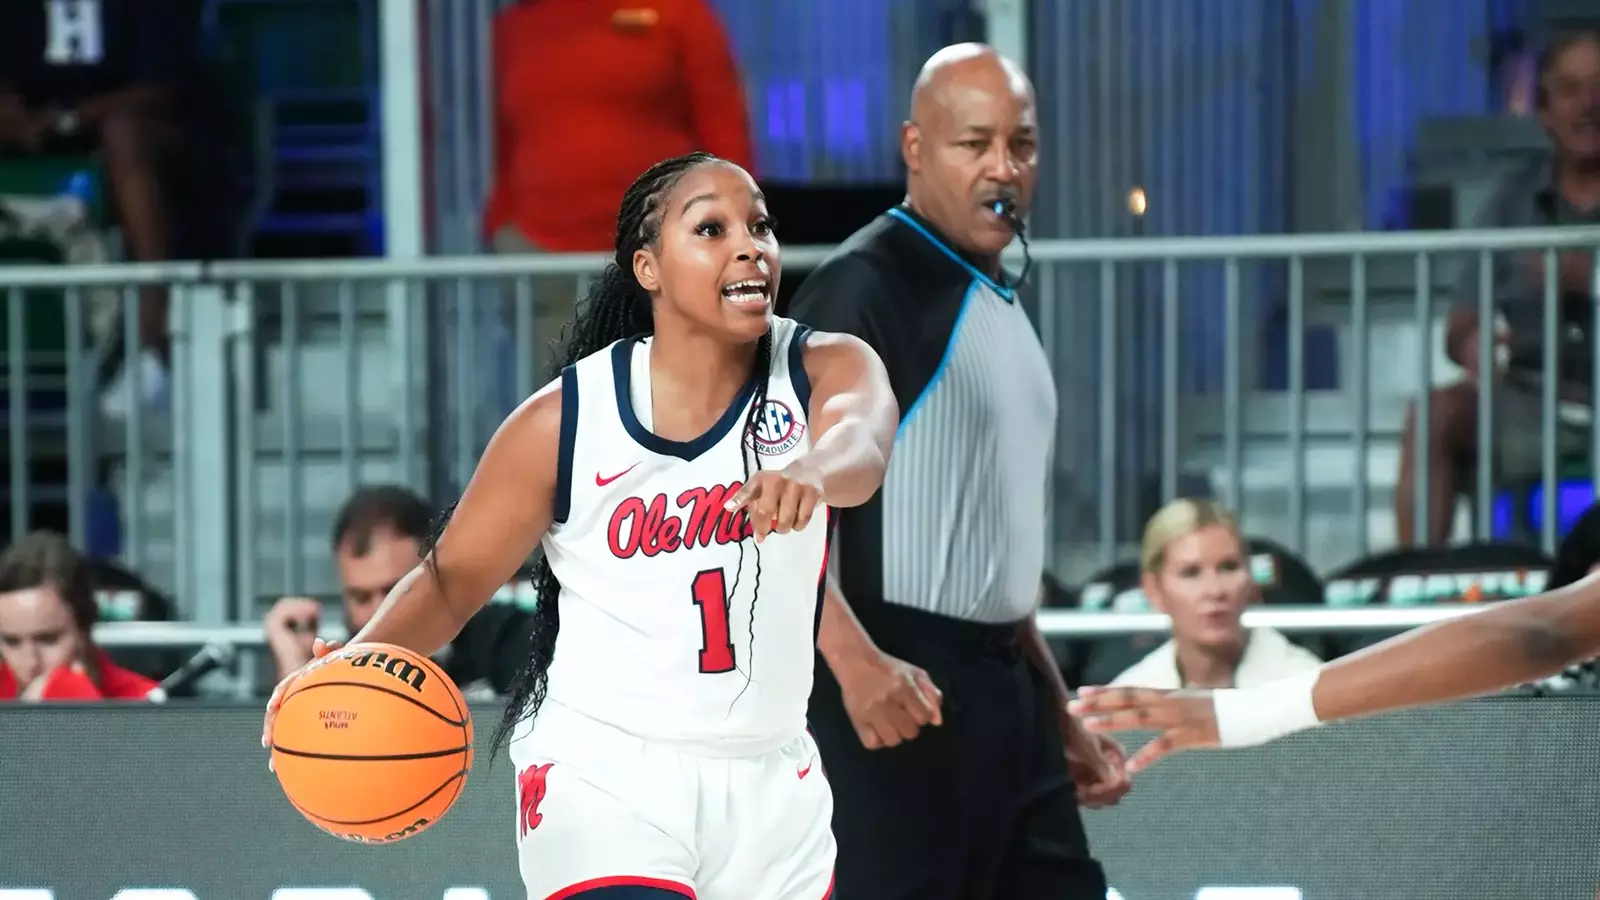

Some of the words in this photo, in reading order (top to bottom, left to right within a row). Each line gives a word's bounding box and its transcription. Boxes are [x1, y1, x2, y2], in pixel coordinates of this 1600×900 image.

[752, 402, 792, 442] SEC
[607, 493, 682, 559] Ole
[676, 481, 777, 548] Mi
[691, 567, 736, 674] 1
[308, 651, 427, 693] Wil
[318, 710, 359, 721] ATLANTIS
